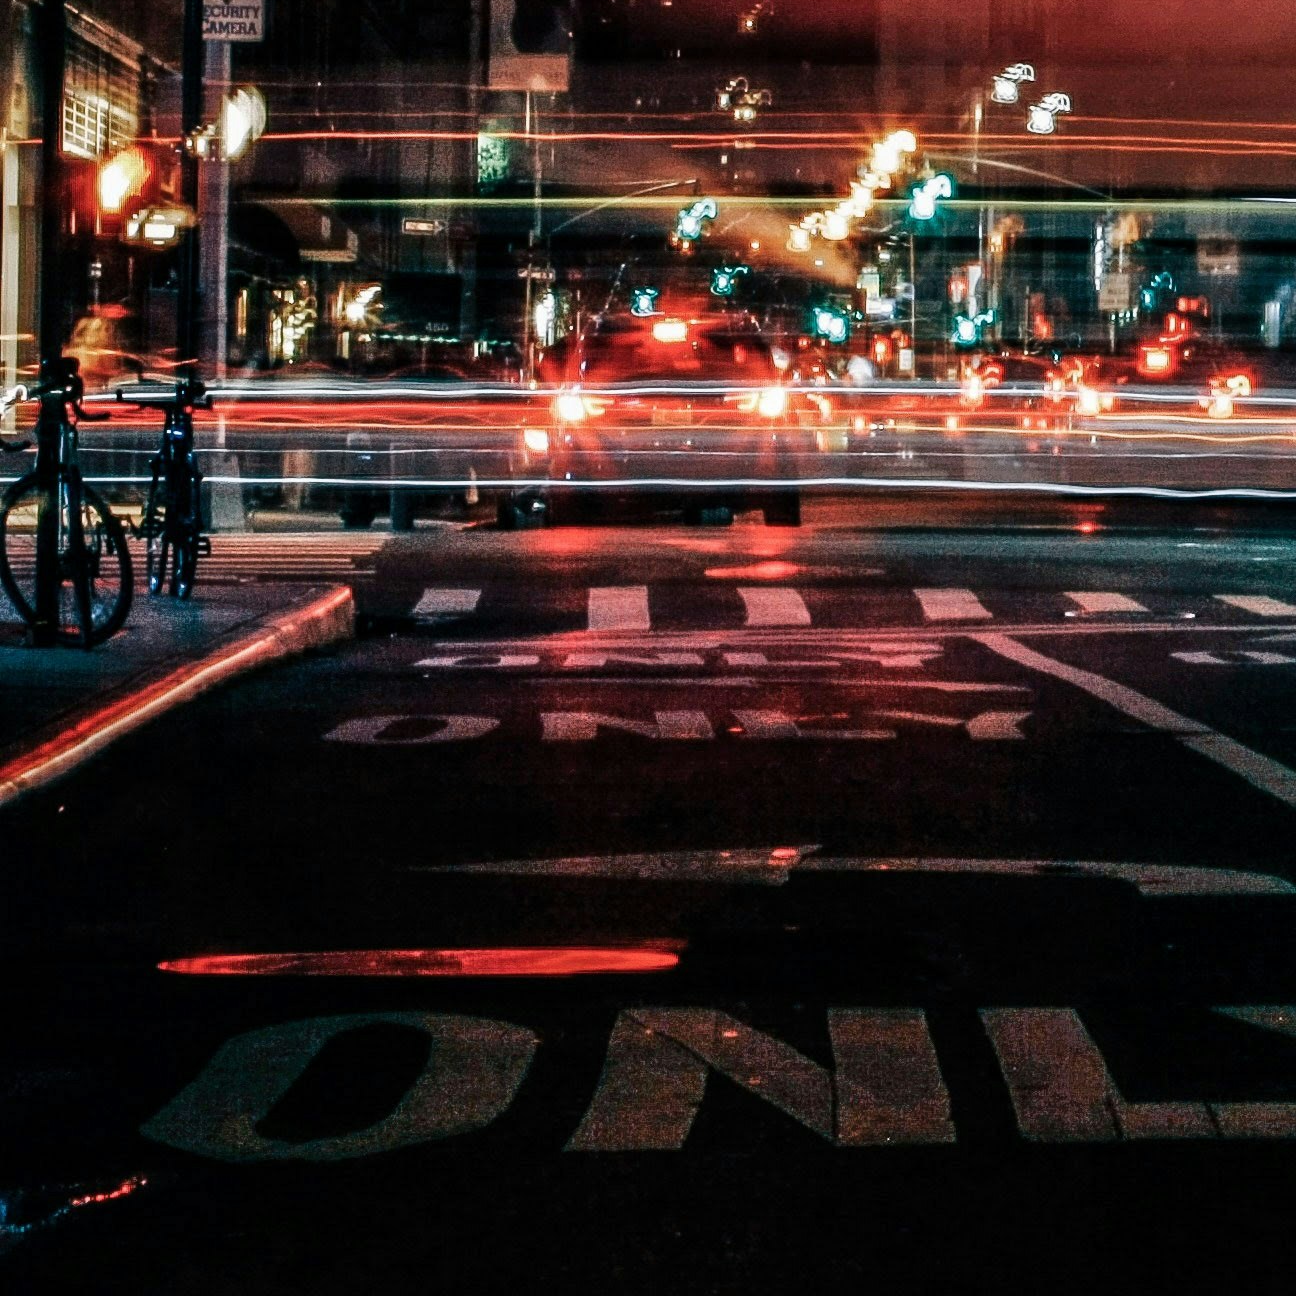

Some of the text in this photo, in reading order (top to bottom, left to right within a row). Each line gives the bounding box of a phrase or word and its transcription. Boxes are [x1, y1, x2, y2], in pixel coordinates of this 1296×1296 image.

[202, 6, 260, 19] ECURITY
[412, 651, 944, 669] ONLY
[321, 709, 1034, 745] ONLY
